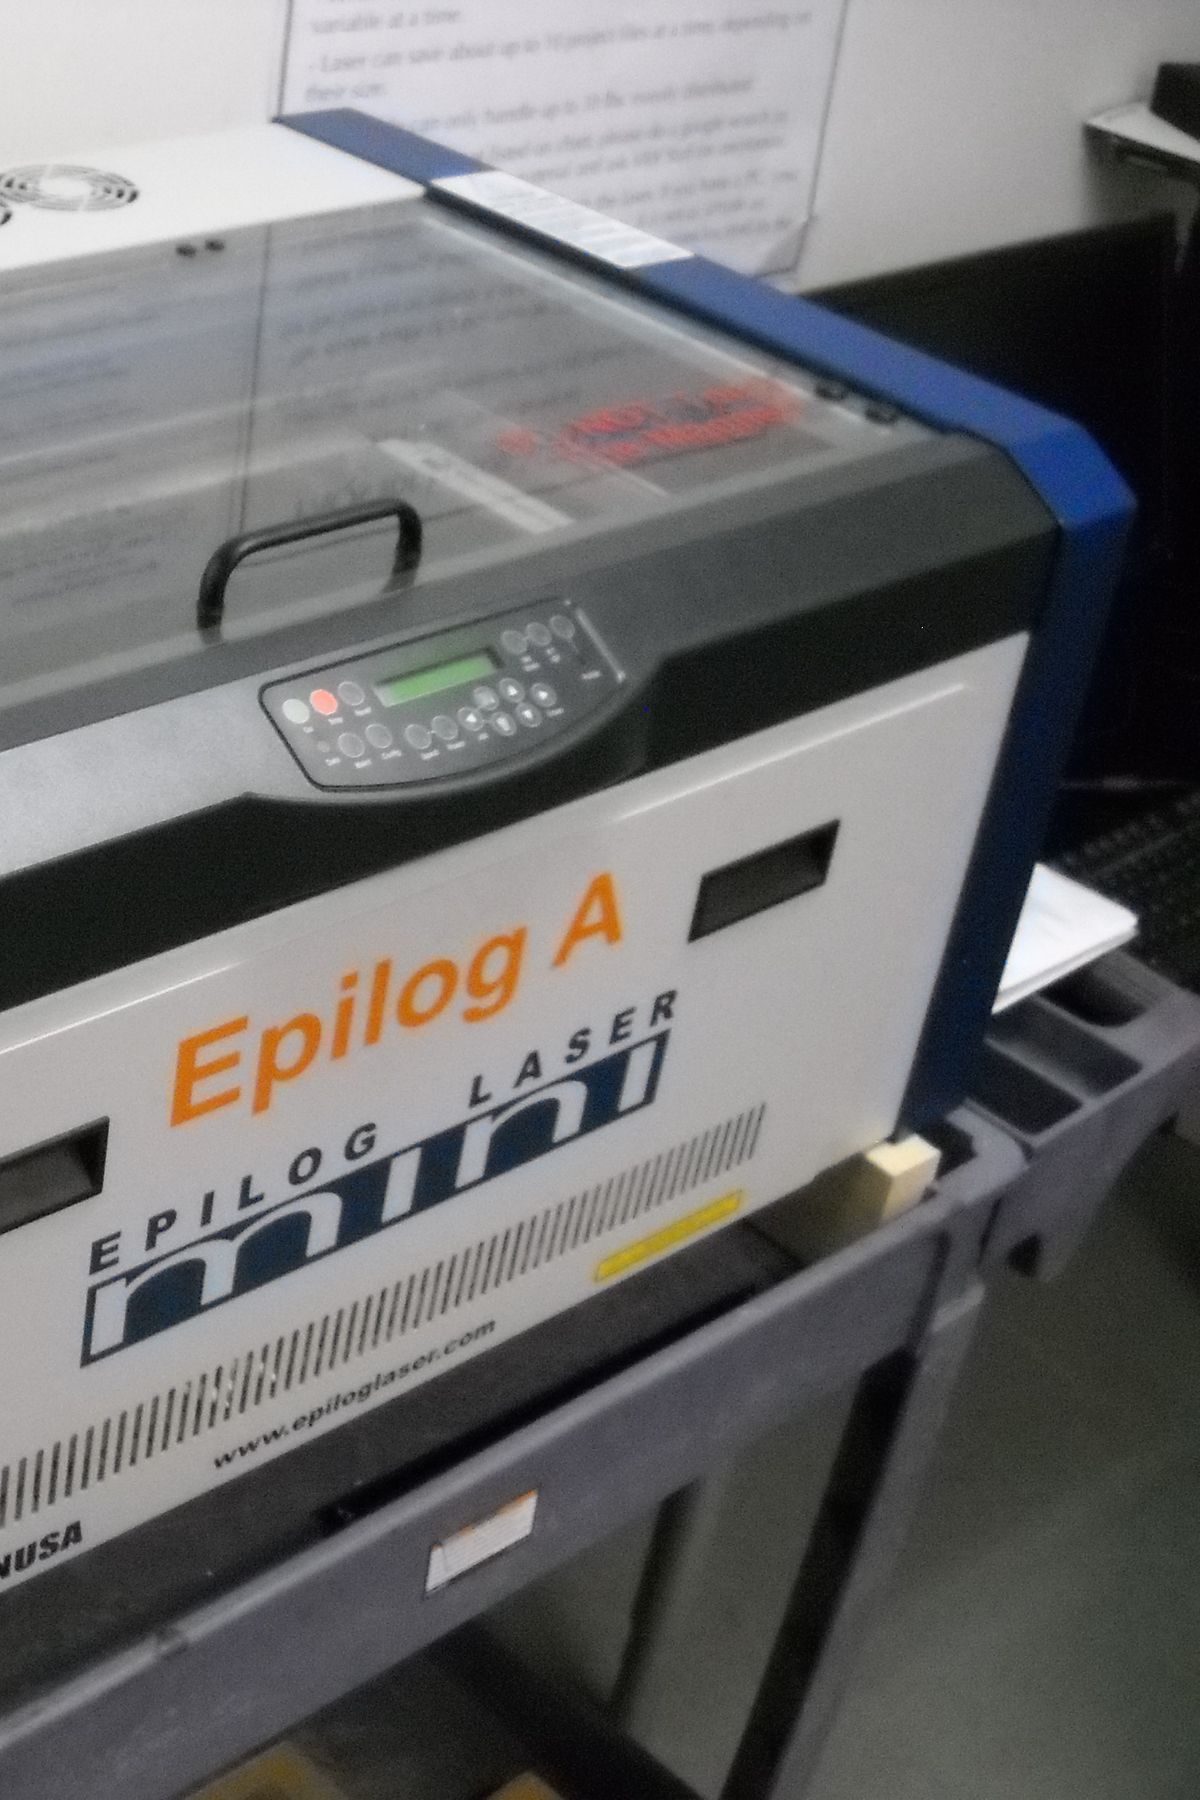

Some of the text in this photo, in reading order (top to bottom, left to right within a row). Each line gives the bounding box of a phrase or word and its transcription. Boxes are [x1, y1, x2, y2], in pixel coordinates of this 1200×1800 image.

[169, 870, 624, 1129] Epilog A
[88, 989, 679, 1276] EPILOG LASER
[213, 1319, 497, 1469] www.epiloglaser.com
